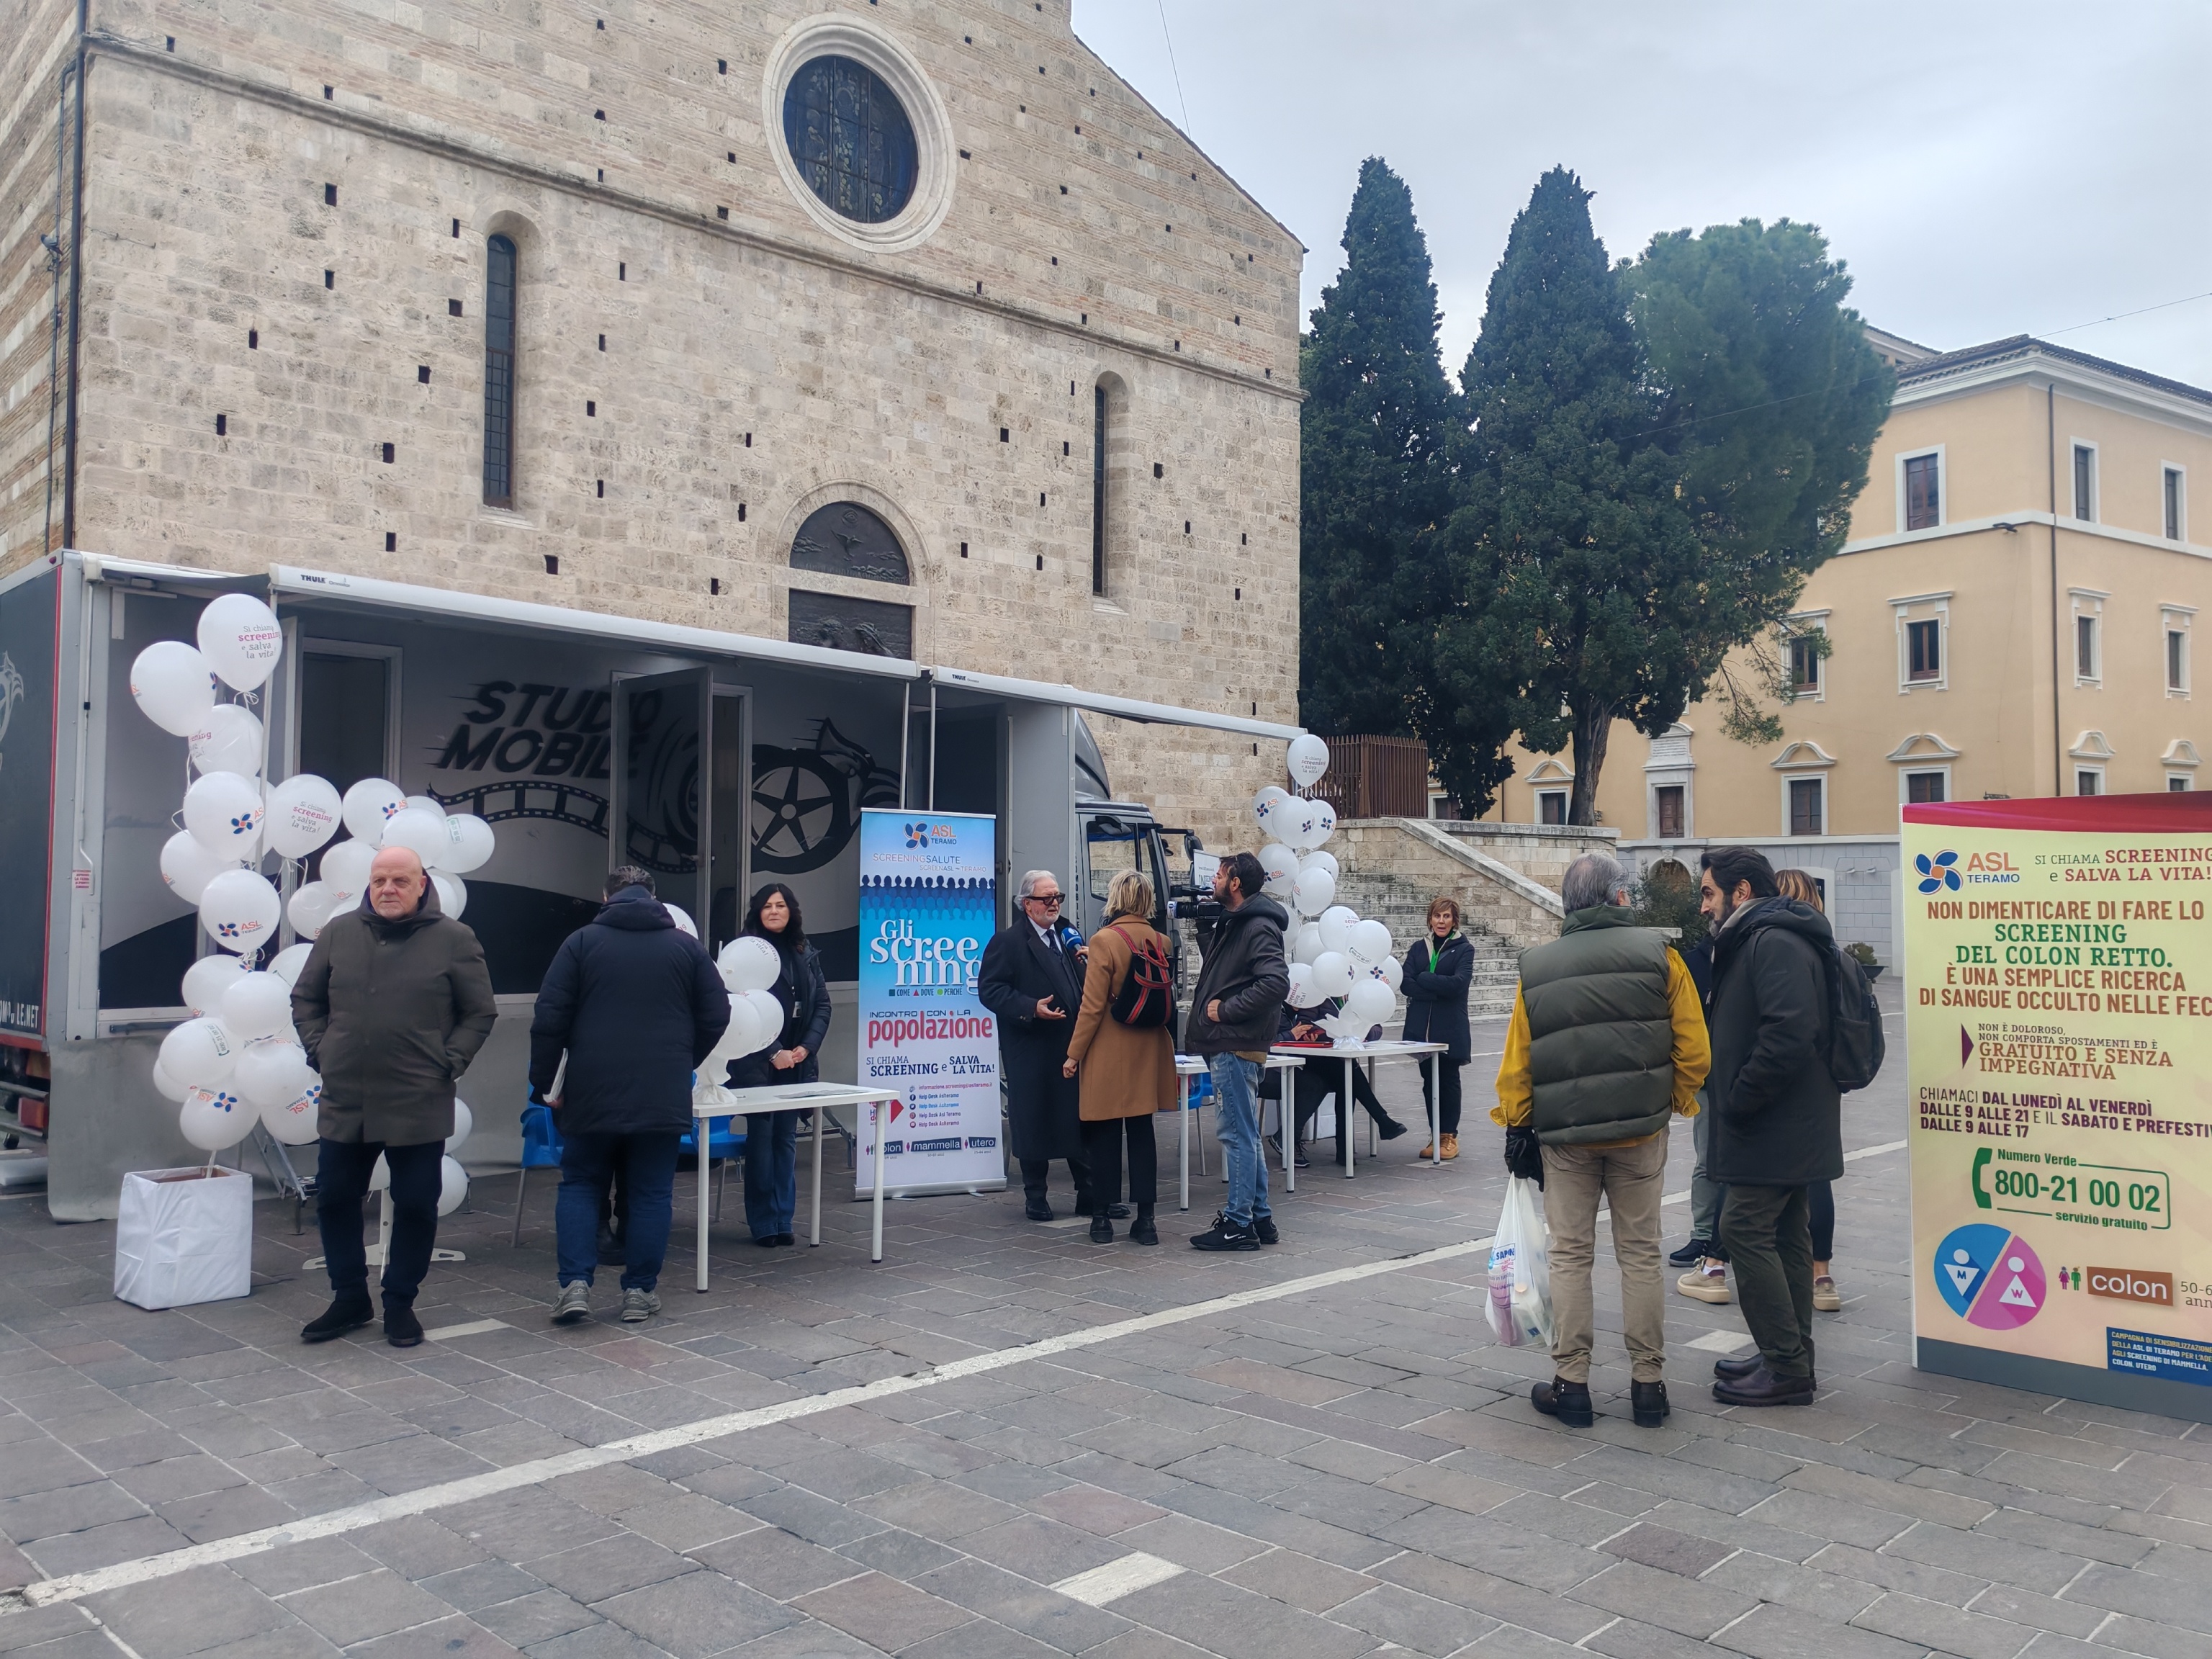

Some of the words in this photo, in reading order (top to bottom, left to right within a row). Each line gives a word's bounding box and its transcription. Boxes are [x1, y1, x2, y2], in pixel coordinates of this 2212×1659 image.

[300, 574, 326, 584] THULE
[293, 806, 333, 823] screening
[297, 815, 316, 826] salva
[302, 823, 320, 834] vita!
[931, 824, 956, 837] ASL
[1967, 852, 2020, 871] ASL
[2035, 855, 2046, 865] SI
[2051, 854, 2100, 865] CHIAMA
[2105, 848, 2212, 863] SCREENING
[1967, 874, 2020, 884] TERAMO
[2049, 871, 2059, 882] e
[2065, 868, 2121, 881] SALVA
[2128, 868, 2153, 881] LA
[2160, 866, 2212, 881] VITA!
[1928, 901, 1963, 920] NON
[1969, 901, 2091, 920] DIMENTICARE
[2098, 901, 2115, 920] DI
[2123, 901, 2172, 920] FARE
[2180, 901, 2204, 920] LO
[241, 920, 261, 930] ASL
[881, 919, 913, 940] Gli
[1995, 924, 2127, 943] SCREENING
[871, 938, 979, 963] scree
[1956, 945, 1997, 963] DEL
[2006, 946, 2081, 966] COLON
[2090, 948, 2173, 968] RETTO.
[1947, 962, 1956, 984] È
[1963, 968, 1998, 986] UNA
[2005, 968, 2095, 989] SEMPLICE
[2102, 971, 2186, 991] RICERCA
[944, 986, 962, 995] PERCHÉ
[1920, 988, 1935, 1005] DI
[1942, 989, 2011, 1009] SANGUE
[2017, 991, 2100, 1012] OCCULTO
[2108, 994, 2169, 1015] NELLE
[868, 1011, 992, 1048] popolazione
[2002, 1022, 2008, 1032] È
[2011, 1025, 2066, 1035] DOLOROSO,
[1979, 1033, 1999, 1042] NON
[2002, 1034, 2055, 1044] COMPORTA
[2059, 1036, 2131, 1048] SPOSTAMENTI
[2134, 1040, 2148, 1049] ED
[2152, 1039, 2158, 1050] È
[949, 1056, 980, 1065] SALVA
[1979, 1042, 2077, 1062] GRATUITO
[2085, 1047, 2097, 1063] E
[2105, 1048, 2173, 1067] SENZA
[871, 1064, 938, 1076] SCREENING
[953, 1066, 966, 1074] LA
[969, 1064, 994, 1074] VITA!
[1980, 1058, 2116, 1080] IMPEGNATIVA
[197, 1092, 215, 1102] ASL
[1920, 1087, 1978, 1104] CHIAMACI
[1982, 1091, 2008, 1105] DAL
[2013, 1093, 2062, 1110] LUNEDÌ
[2067, 1097, 2085, 1111] AL
[2089, 1099, 2152, 1117] VENERDÌ
[289, 1100, 309, 1114] ASL
[1920, 1102, 1961, 1117] DALLE
[1965, 1105, 1973, 1118] 9
[1977, 1106, 2011, 1121] ALLE
[2015, 1109, 2029, 1123] 21
[2033, 1110, 2041, 1124] E
[2046, 1111, 2057, 1125] IL
[2062, 1112, 2118, 1130] SABATO
[2123, 1117, 2132, 1131] E
[2136, 1118, 2212, 1138] PREFESTI
[1920, 1117, 1961, 1133] DALLE
[1966, 1120, 1973, 1133] 9
[1978, 1121, 2011, 1136] ALLE
[2015, 1124, 2029, 1138] 17
[884, 1143, 901, 1152] olon
[914, 1138, 960, 1150] mammella
[1998, 1148, 2041, 1164] Numero
[2045, 1153, 2077, 1166] Verde
[1995, 1169, 2077, 1203] 800-21
[2090, 1179, 2120, 1208] 00
[2129, 1183, 2161, 1213] 02
[2056, 1210, 2099, 1226] servizio
[2102, 1216, 2148, 1231] gratuito
[1957, 1270, 1966, 1280] M
[2011, 1288, 2023, 1298] W
[2092, 1274, 2167, 1299] colon
[2112, 1331, 2144, 1342] CAMPAGNA
[2154, 1347, 2180, 1357] TERAMO
[2127, 1352, 2162, 1363] SCREENING
[2172, 1359, 2208, 1371] MAMMELLA,
[2136, 1362, 2156, 1371] UTERO
